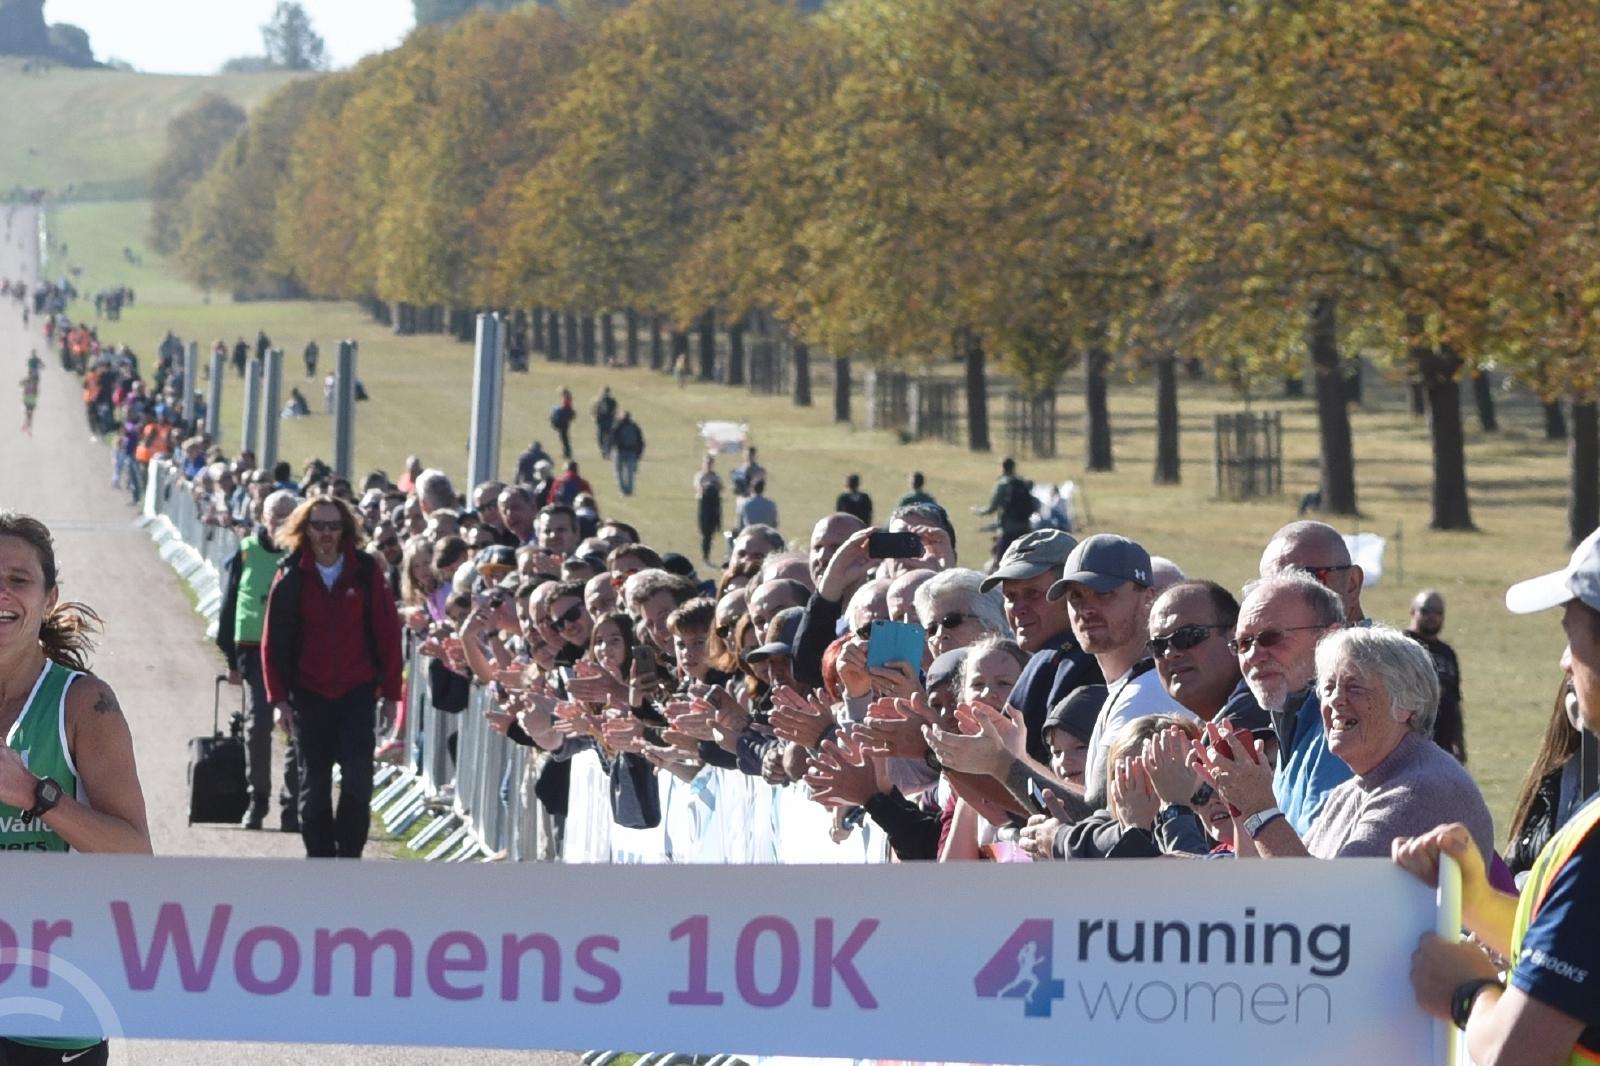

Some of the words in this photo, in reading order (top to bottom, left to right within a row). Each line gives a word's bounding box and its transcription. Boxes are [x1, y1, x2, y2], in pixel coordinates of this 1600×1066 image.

[109, 900, 622, 1004] Womens
[667, 914, 880, 1010] 10K
[1077, 906, 1351, 978] running
[1531, 949, 1589, 984] BROOKS
[1077, 980, 1333, 1025] women
